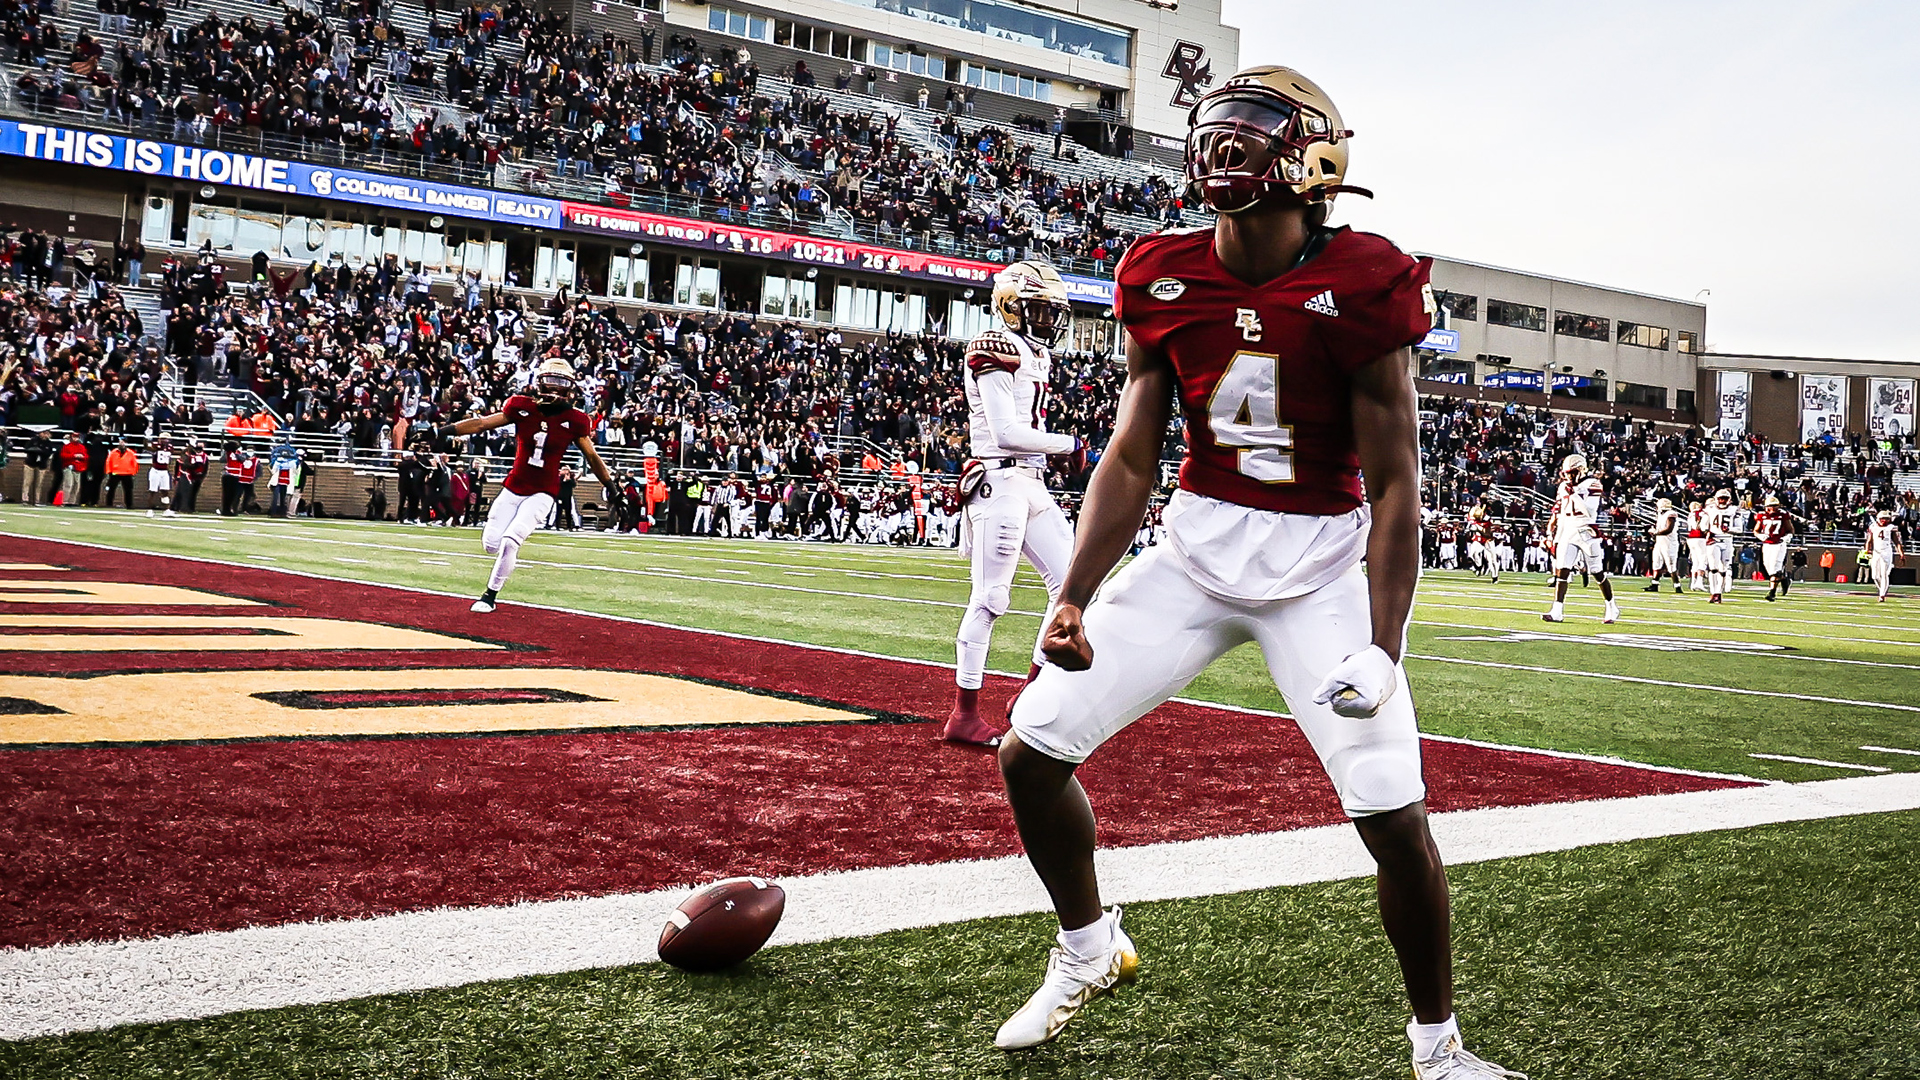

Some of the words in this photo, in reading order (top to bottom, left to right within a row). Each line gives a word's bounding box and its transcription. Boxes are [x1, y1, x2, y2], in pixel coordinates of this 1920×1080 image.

[18, 123, 114, 168] THIS
[124, 138, 163, 174] IS
[173, 145, 298, 193] HOME.
[335, 177, 423, 203] COLDWELL
[425, 189, 490, 213] BANKER
[496, 200, 553, 220] REALTY
[573, 212, 598, 227] 1ST
[600, 216, 640, 233] DOWN
[646, 222, 665, 236] 10
[666, 225, 684, 239] TO
[685, 228, 704, 242] GO
[750, 236, 772, 254] 16
[793, 241, 845, 265] 10:21
[862, 253, 884, 270] 26
[928, 263, 955, 278] BALL
[955, 267, 971, 280] ON
[971, 268, 987, 282] 36
[1153, 281, 1181, 294] ACC
[1304, 300, 1340, 318] adidas
[1206, 350, 1296, 484] 4
[1829, 414, 1842, 428] 60
[527, 430, 549, 468] 1
[1763, 519, 1782, 535] 77
[1878, 530, 1885, 541] 4
